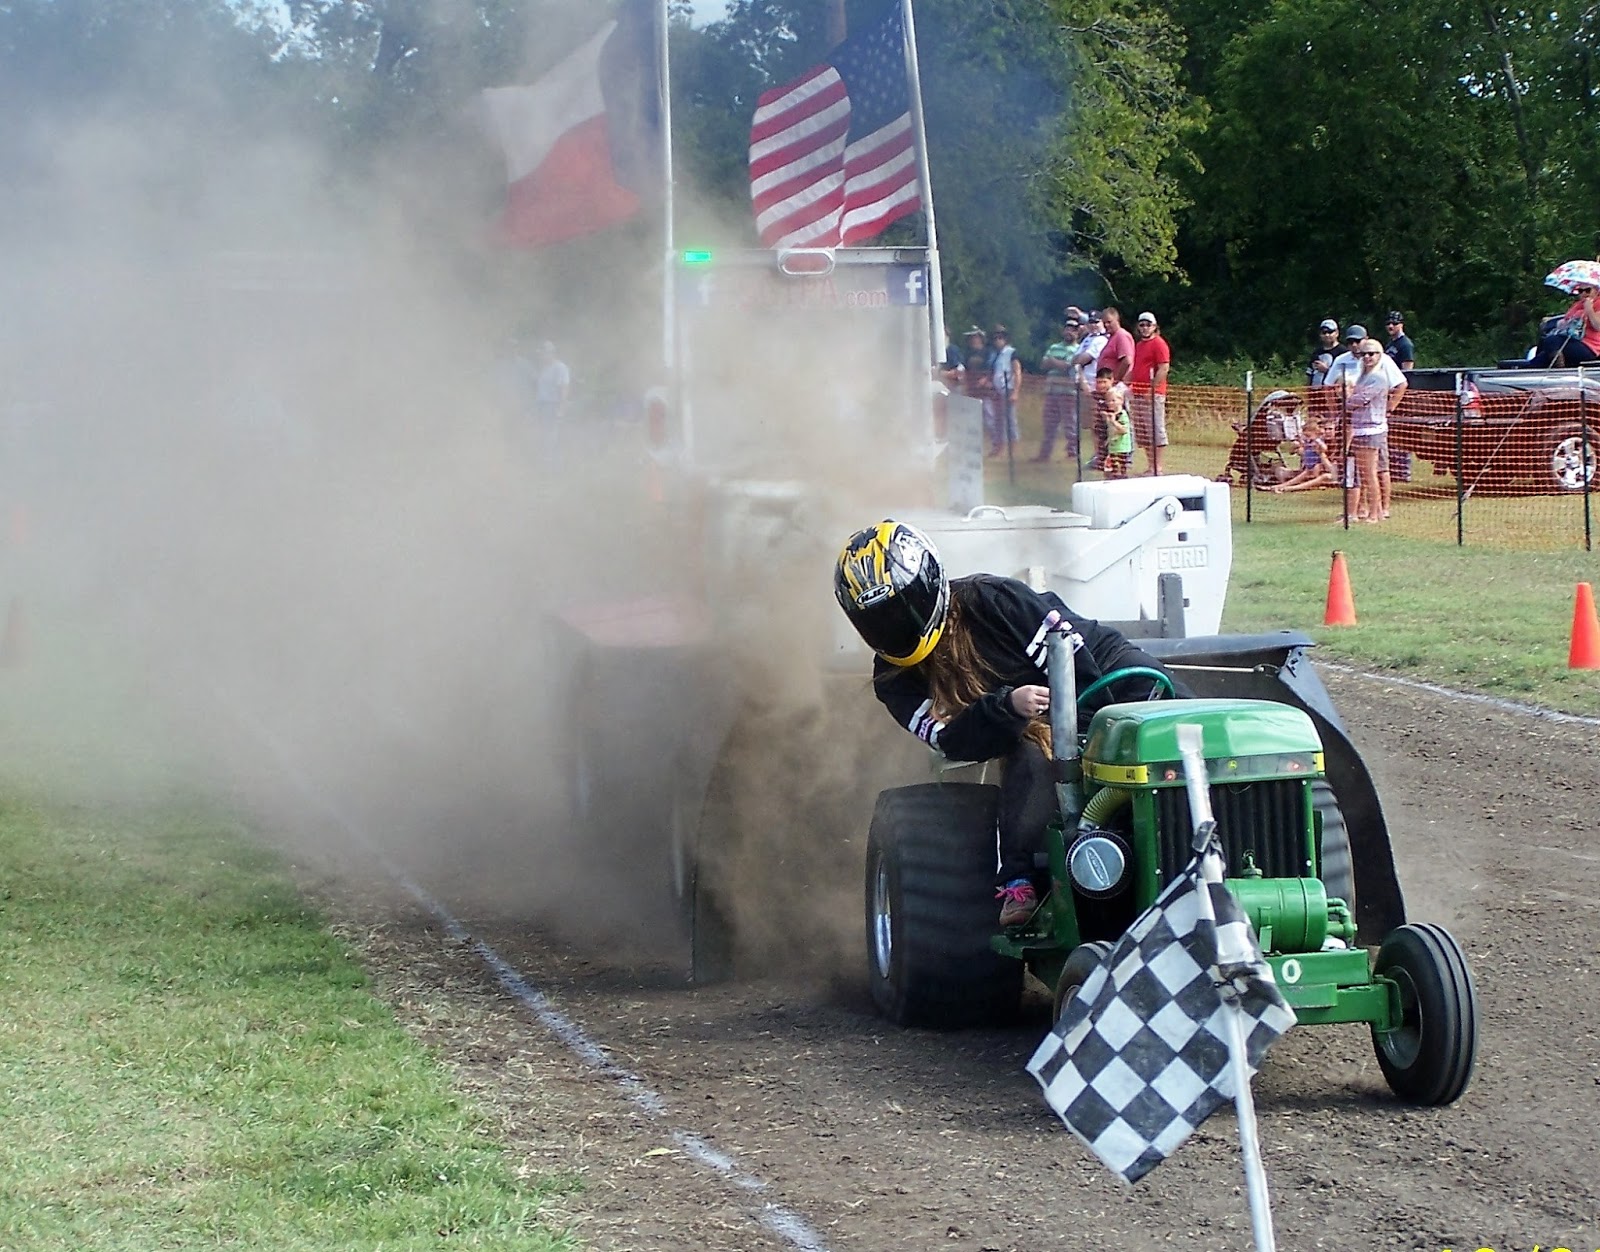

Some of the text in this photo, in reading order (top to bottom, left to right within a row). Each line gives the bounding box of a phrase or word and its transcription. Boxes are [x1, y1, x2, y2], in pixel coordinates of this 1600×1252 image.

[905, 270, 921, 304] f
[1158, 546, 1208, 569] FORD
[861, 585, 887, 603] HJC
